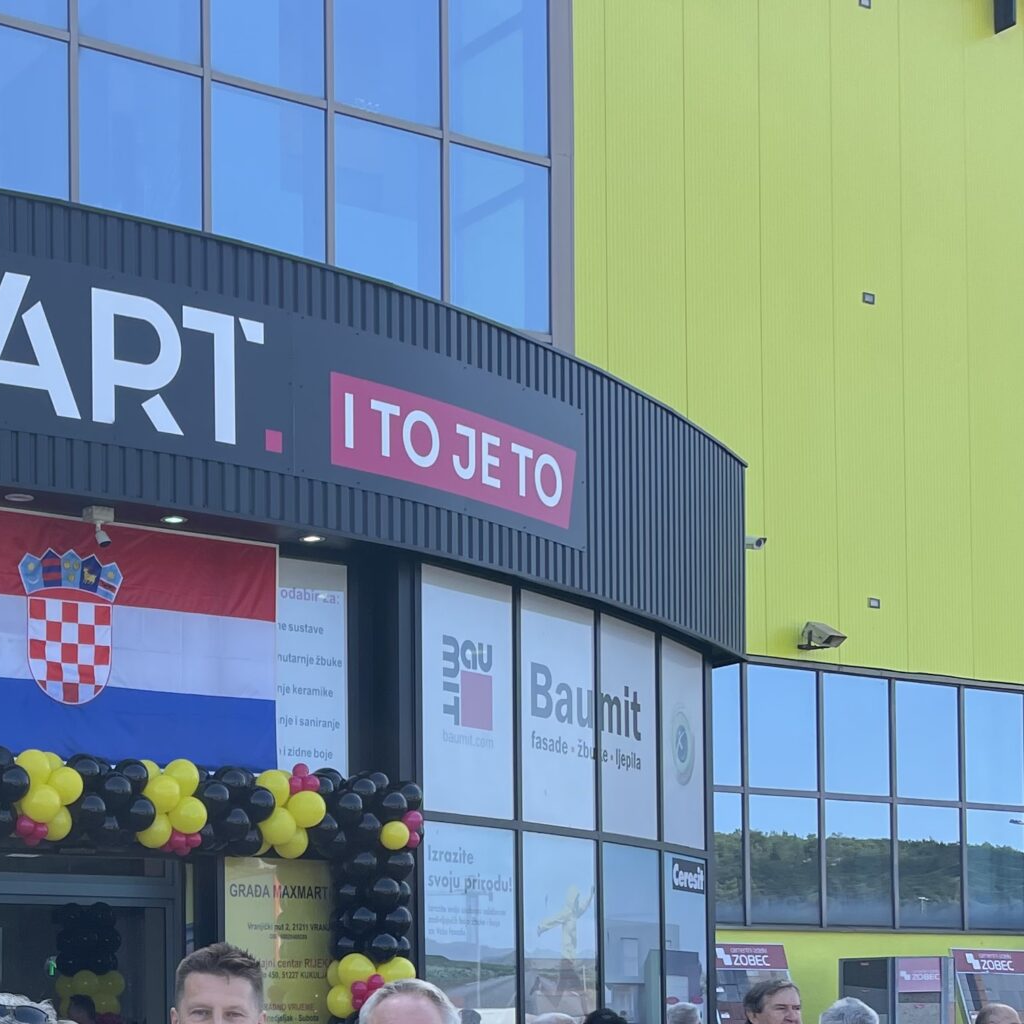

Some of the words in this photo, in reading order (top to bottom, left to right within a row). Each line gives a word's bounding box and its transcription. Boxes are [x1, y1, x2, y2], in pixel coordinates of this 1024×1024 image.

[344, 392, 354, 449] I
[371, 399, 440, 468] TO
[452, 423, 501, 489] JE
[511, 442, 563, 507] TO
[280, 587, 319, 602] odabir
[288, 623, 324, 635] sustave
[315, 655, 343, 668] žbuke
[292, 684, 334, 698] keramike
[530, 662, 642, 741] Baumit
[299, 716, 341, 732] saniranje
[287, 746, 313, 758] zidne
[313, 748, 334, 761] boje
[531, 730, 569, 755] fasade
[615, 748, 642, 771] ljepila
[427, 844, 474, 865] Izrazite
[427, 870, 461, 893] svoju
[464, 872, 512, 894] prirodu!
[672, 862, 704, 890] Ceresit
[229, 883, 271, 898] GRAĐA
[273, 885, 329, 900] MAXMART
[277, 959, 303, 969] centar
[731, 954, 771, 967] ZOBEC
[980, 959, 1015, 971] ZOBEC
[912, 973, 940, 981] ZOBEC
